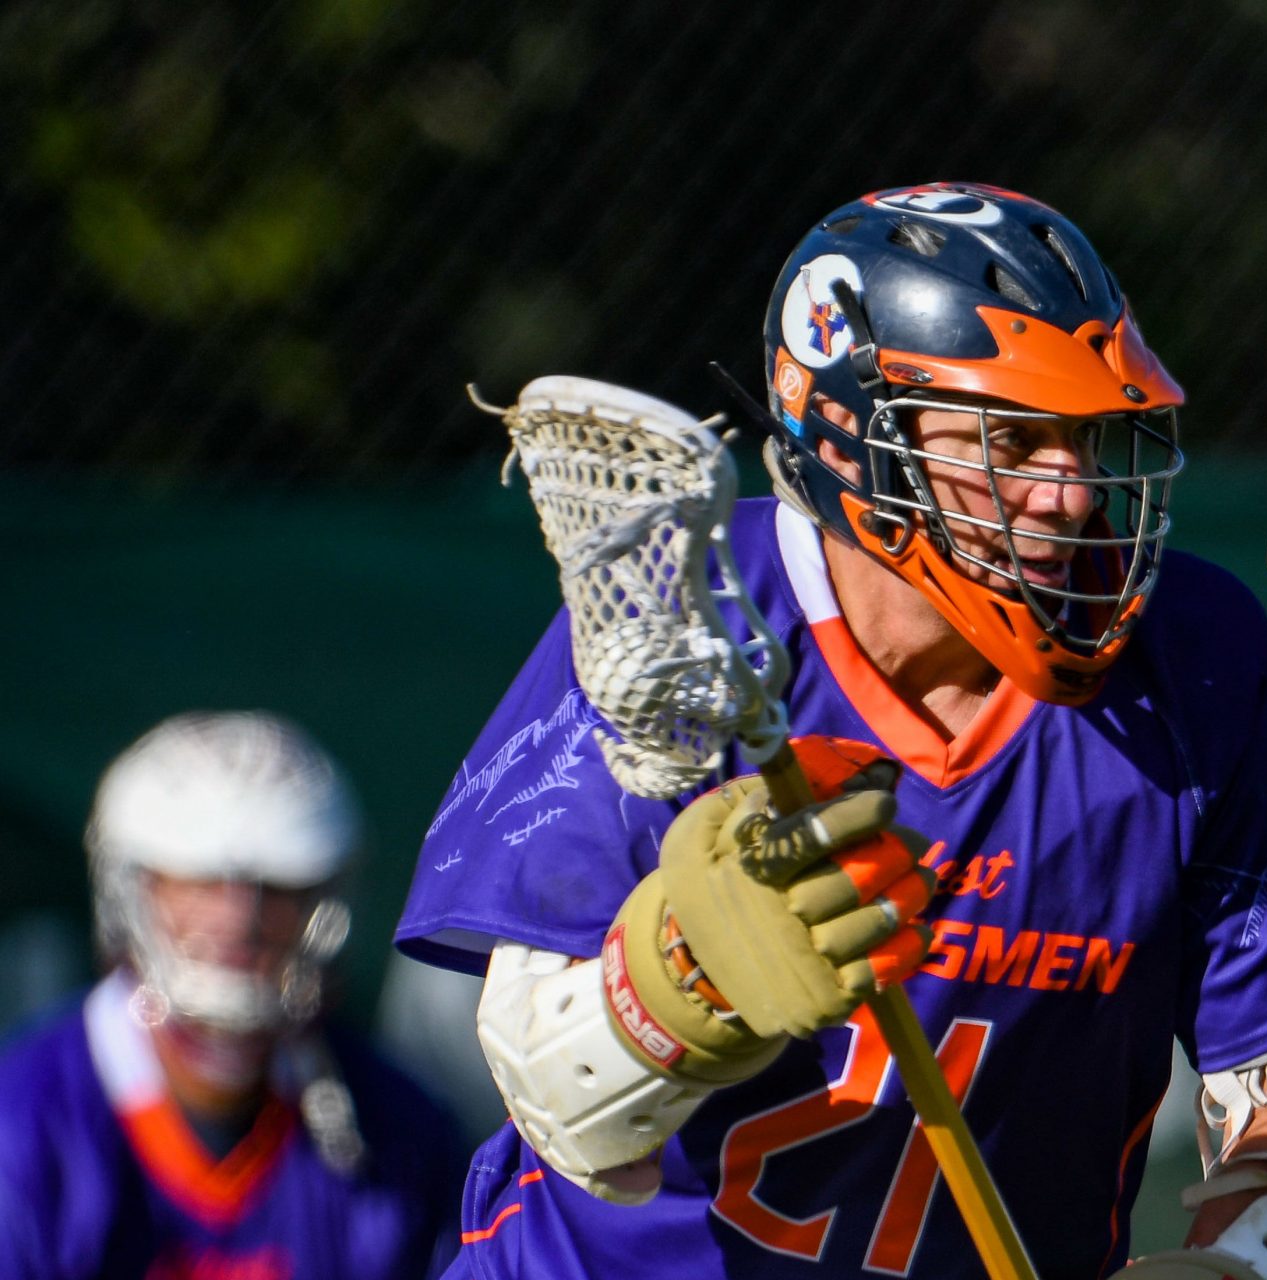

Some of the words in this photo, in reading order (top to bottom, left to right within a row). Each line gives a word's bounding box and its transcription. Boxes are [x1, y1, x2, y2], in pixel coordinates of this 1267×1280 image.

[606, 938, 677, 1061] BRINE
[918, 919, 1136, 994] SMEN
[711, 1003, 992, 1279] 21
